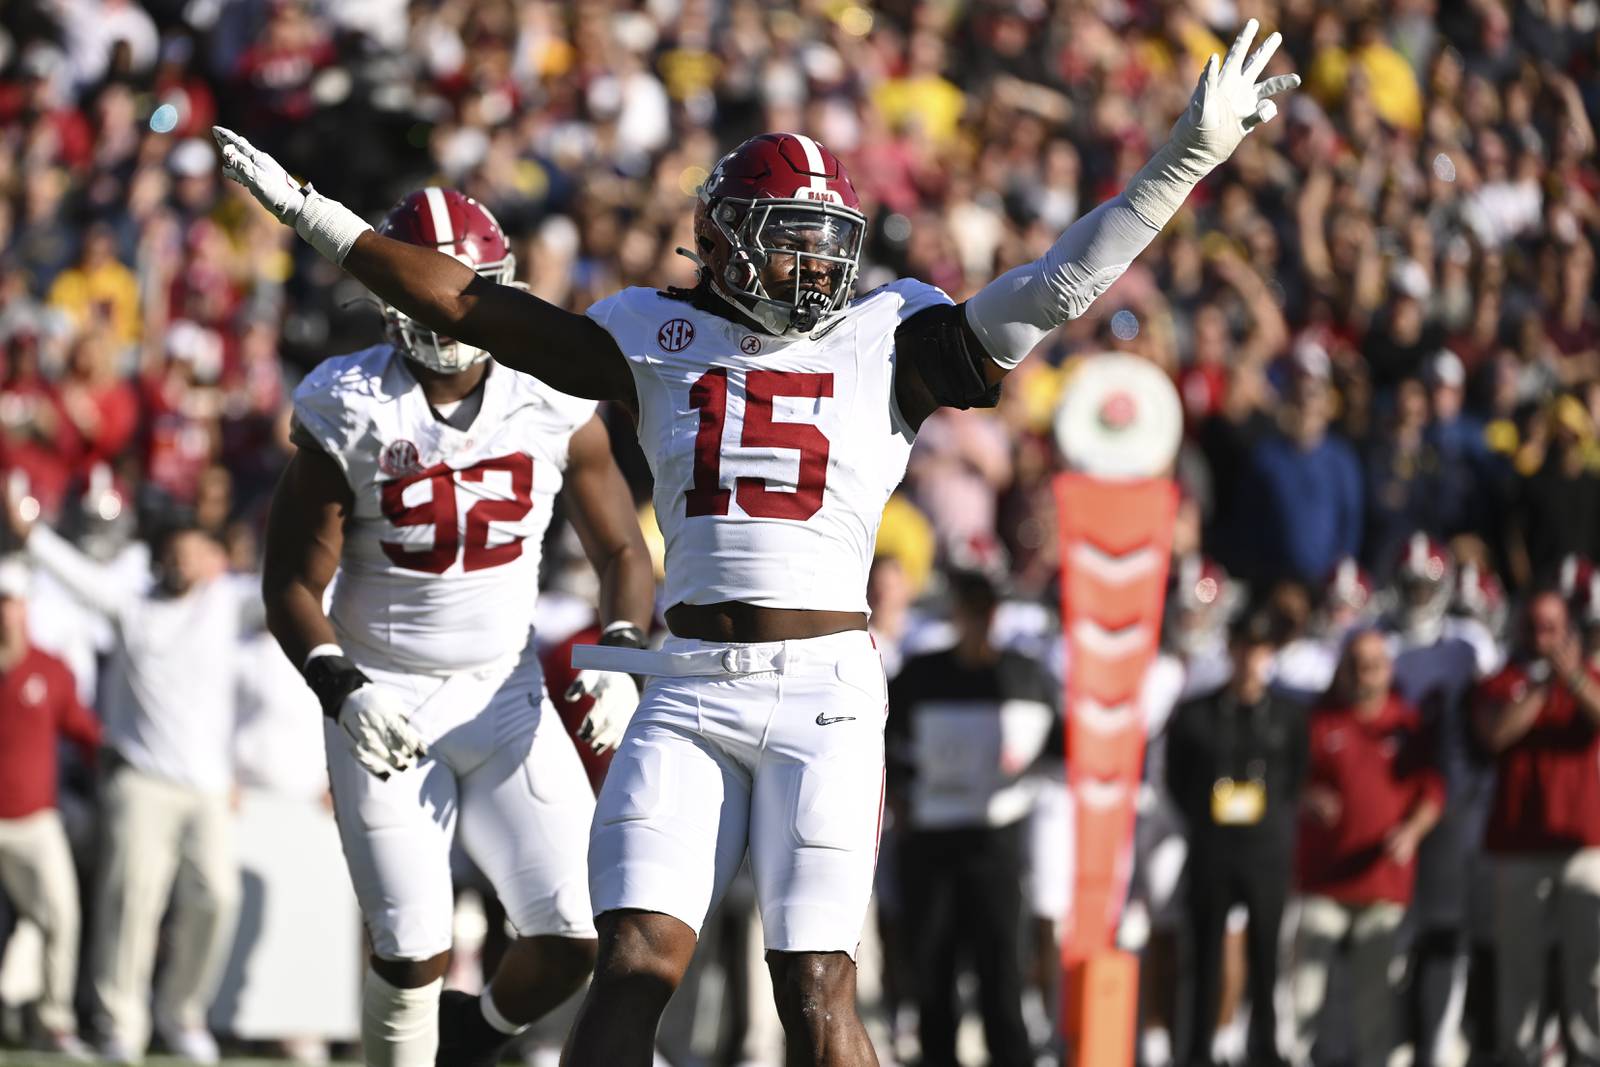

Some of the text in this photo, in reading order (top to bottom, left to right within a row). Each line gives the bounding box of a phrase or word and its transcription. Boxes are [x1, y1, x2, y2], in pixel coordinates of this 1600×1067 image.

[807, 191, 835, 203] BAMA
[658, 318, 695, 352] SEC
[684, 367, 834, 522] 15
[379, 451, 534, 575] 92
